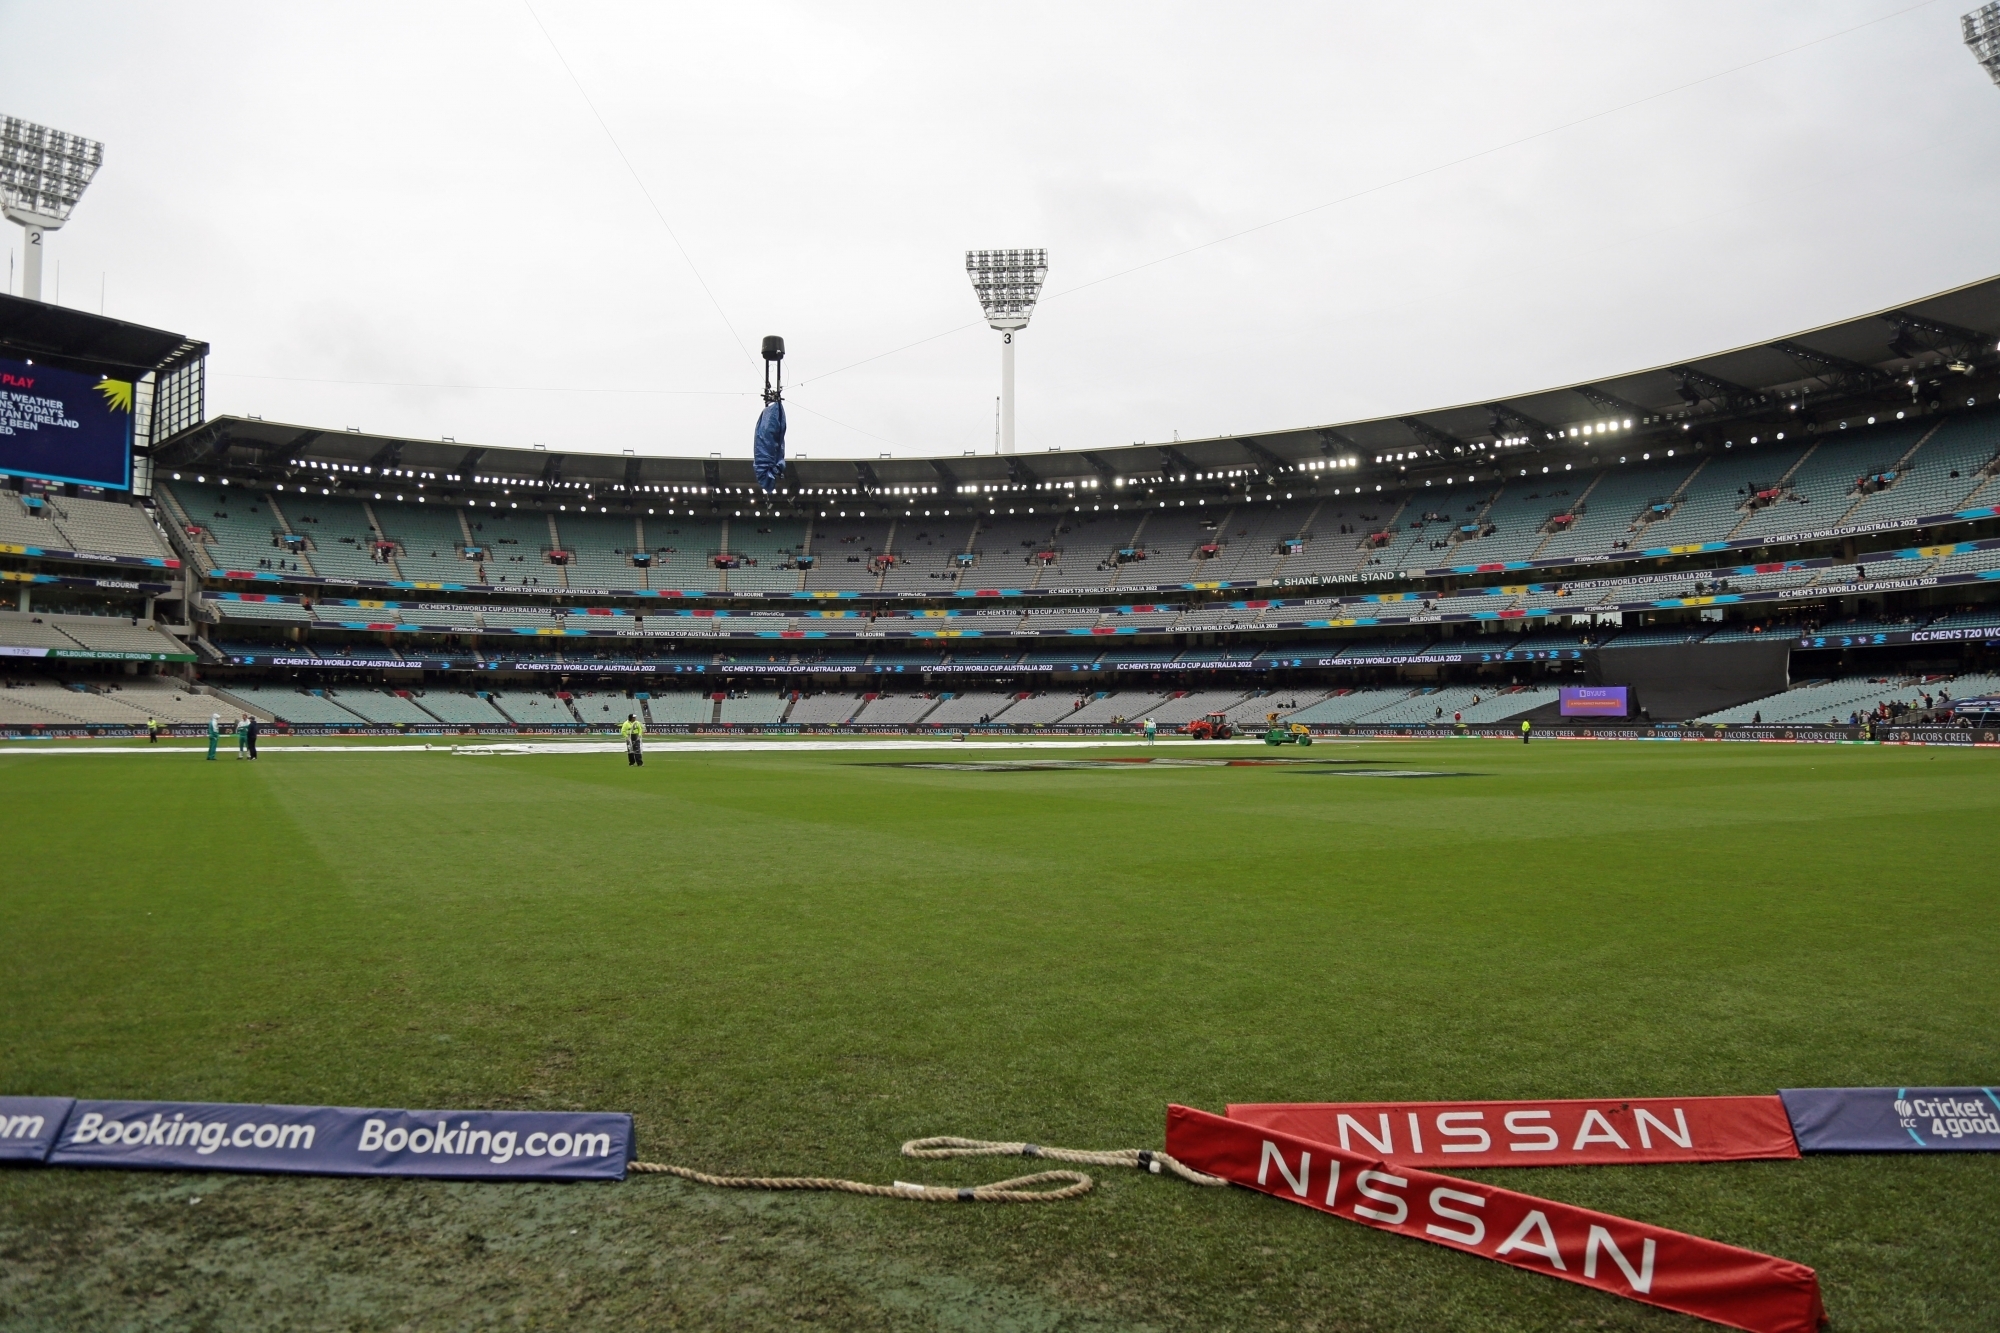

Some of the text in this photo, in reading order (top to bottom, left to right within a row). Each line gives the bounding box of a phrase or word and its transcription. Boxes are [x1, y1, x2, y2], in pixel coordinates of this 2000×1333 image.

[31, 232, 41, 245] 2
[1004, 333, 1011, 344] 3
[2, 374, 34, 388] PLAY
[10, 392, 63, 409] WEATHER
[18, 403, 64, 418] TODAY'S
[10, 418, 38, 430] BEEN
[24, 412, 32, 420] V
[34, 414, 79, 428] IRELAND
[1777, 533, 1798, 542] MEN'S
[1813, 528, 1839, 538] WORLD
[1857, 521, 1898, 532] AUSTRALIA
[1900, 519, 1917, 527] 2022
[96, 580, 139, 589] MELBOURNE
[1285, 572, 1394, 585] SHANE WARNE STAND
[1562, 581, 1573, 589] ICC
[1574, 580, 1596, 588] MEN'S
[1597, 579, 1610, 587] T20
[1610, 577, 1637, 586] WORLD
[1654, 573, 1694, 582] AUSTRALIA
[1792, 588, 1813, 596] MEN'S
[1829, 585, 1856, 593] WORLD
[1875, 580, 1917, 590] AUSTRALIA
[1911, 632, 1930, 641] ICC
[1931, 630, 1961, 640] MEN'S
[1963, 629, 1982, 638] T20
[1945, 733, 1972, 741] CREEK
[1914, 1098, 1988, 1117] Cricket
[1336, 1108, 1692, 1154] NISSAN
[1900, 1119, 1917, 1128] ICC
[1931, 1113, 2000, 1138] 4good
[72, 1113, 315, 1154] Booking.com
[358, 1118, 610, 1164] Booking.com
[1256, 1140, 1656, 1294] NISSAN
